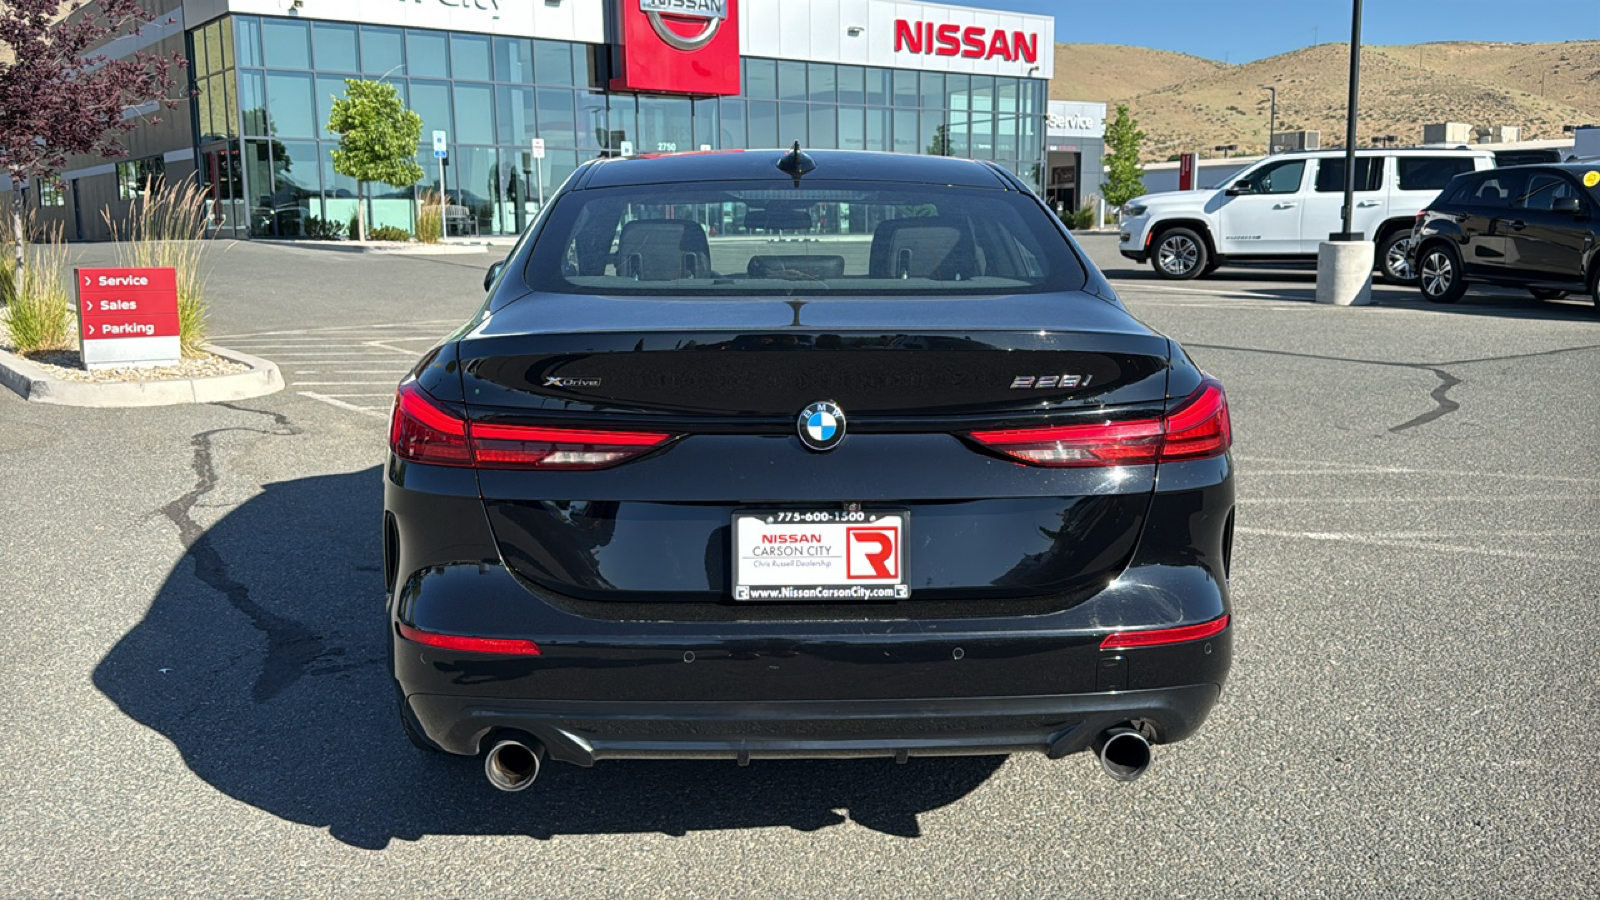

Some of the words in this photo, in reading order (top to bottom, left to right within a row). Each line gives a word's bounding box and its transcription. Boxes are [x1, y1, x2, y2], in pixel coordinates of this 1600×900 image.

[894, 18, 1038, 63] NISSAN
[1048, 112, 1094, 130] Service
[656, 142, 677, 151] 2750
[98, 274, 149, 286] Service
[100, 299, 137, 310] Sales
[102, 322, 155, 335] Parking
[801, 403, 842, 419] BMW
[777, 511, 865, 522] 775-600-1500
[762, 533, 822, 544] NISSAN
[752, 545, 804, 557] CARSON
[807, 545, 832, 556] CITY
[753, 559, 771, 568] Chris
[772, 559, 795, 568] Russell
[796, 559, 832, 569] Dealership
[750, 585, 894, 600] www.NissanCarsonCity.com
